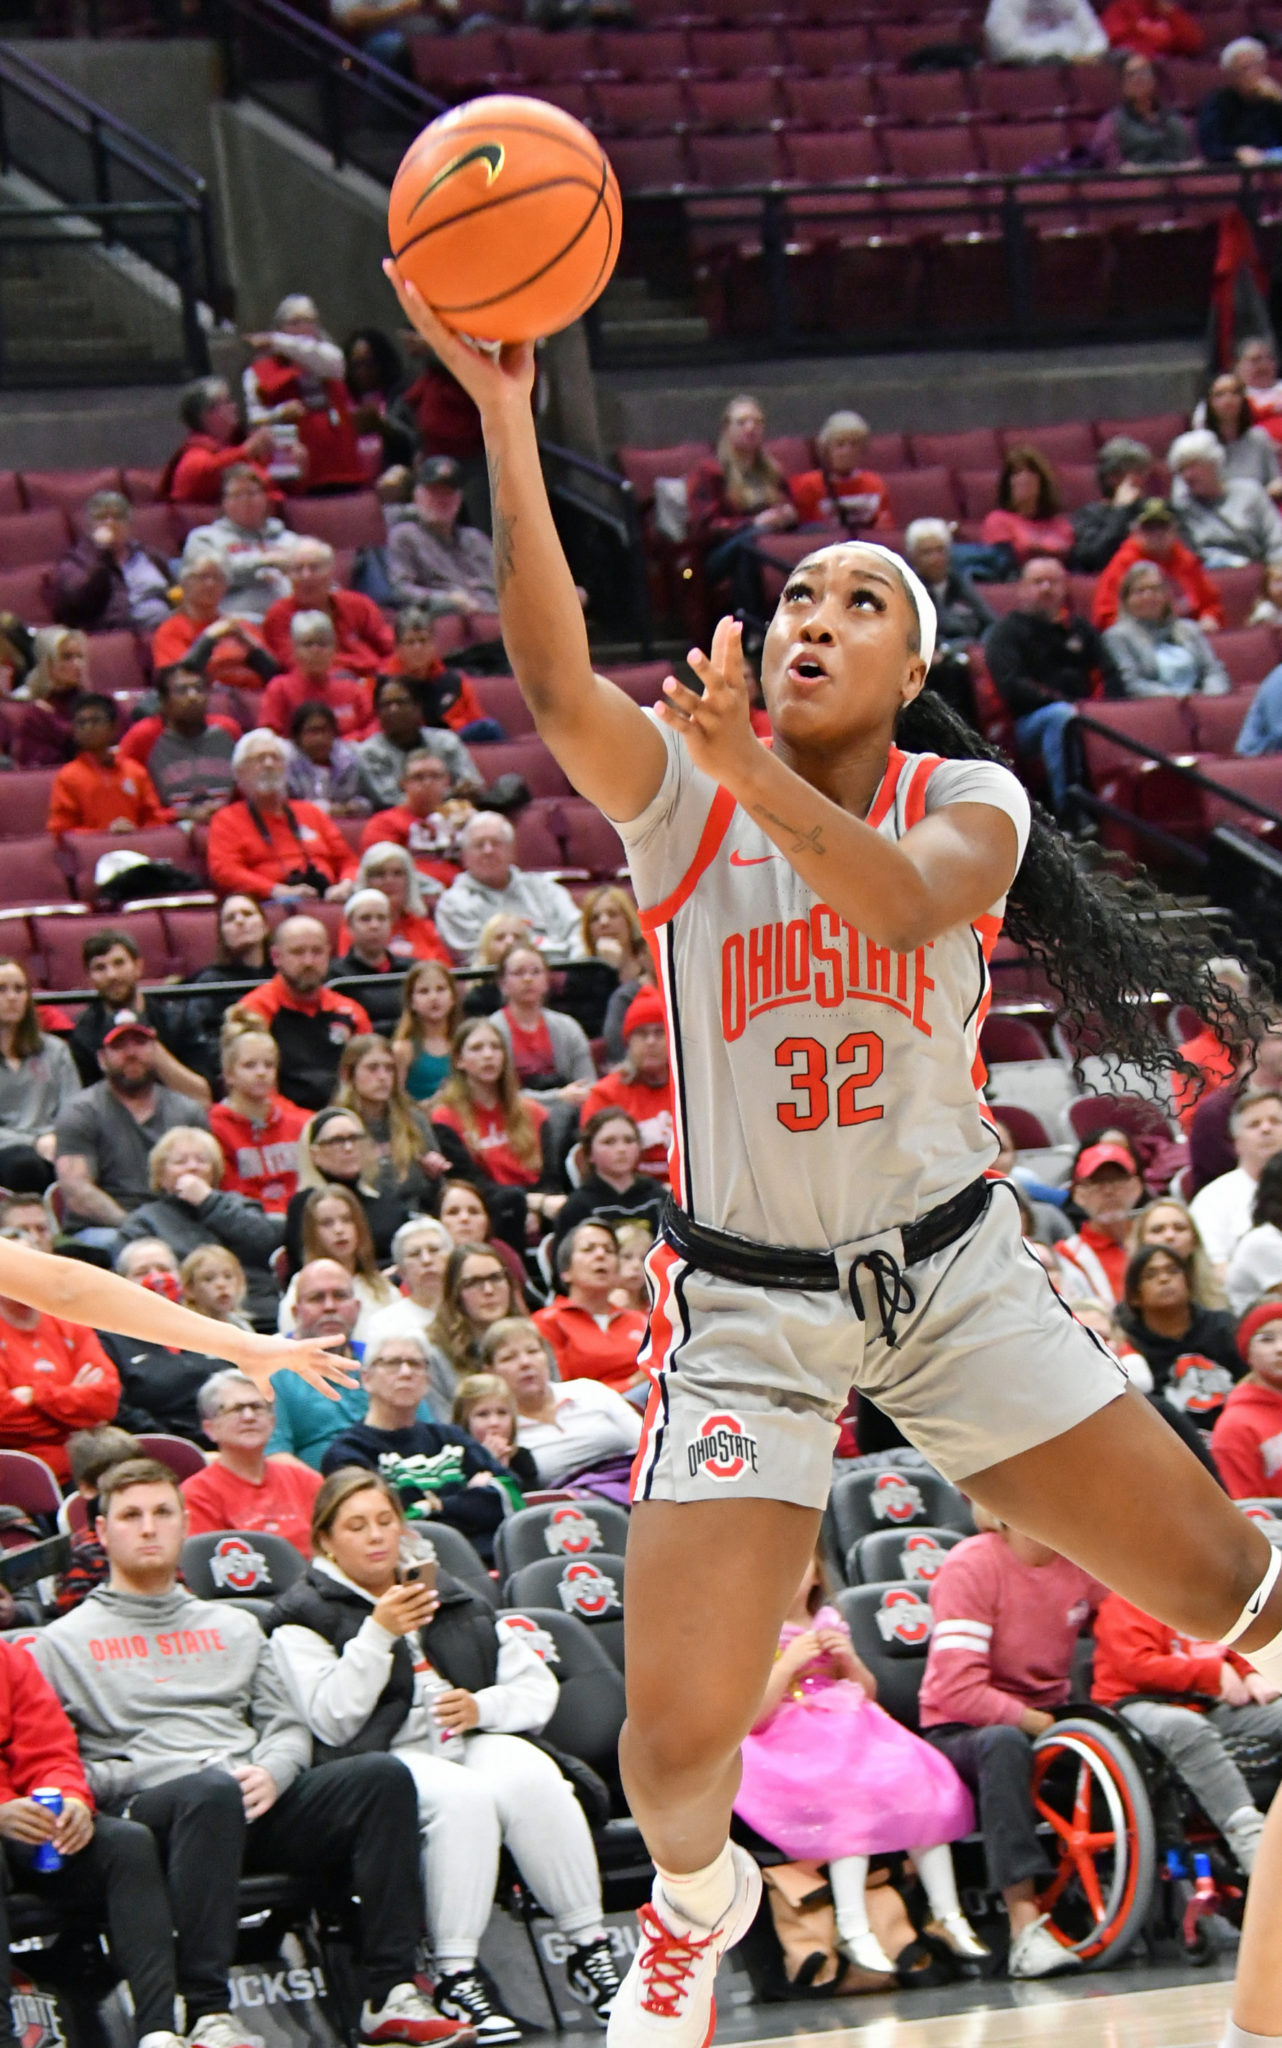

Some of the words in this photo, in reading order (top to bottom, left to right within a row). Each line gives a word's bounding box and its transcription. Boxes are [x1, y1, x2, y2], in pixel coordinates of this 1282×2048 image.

[774, 1030, 885, 1133] 32
[88, 1634, 150, 1662] OHIO
[155, 1628, 228, 1656] STATE
